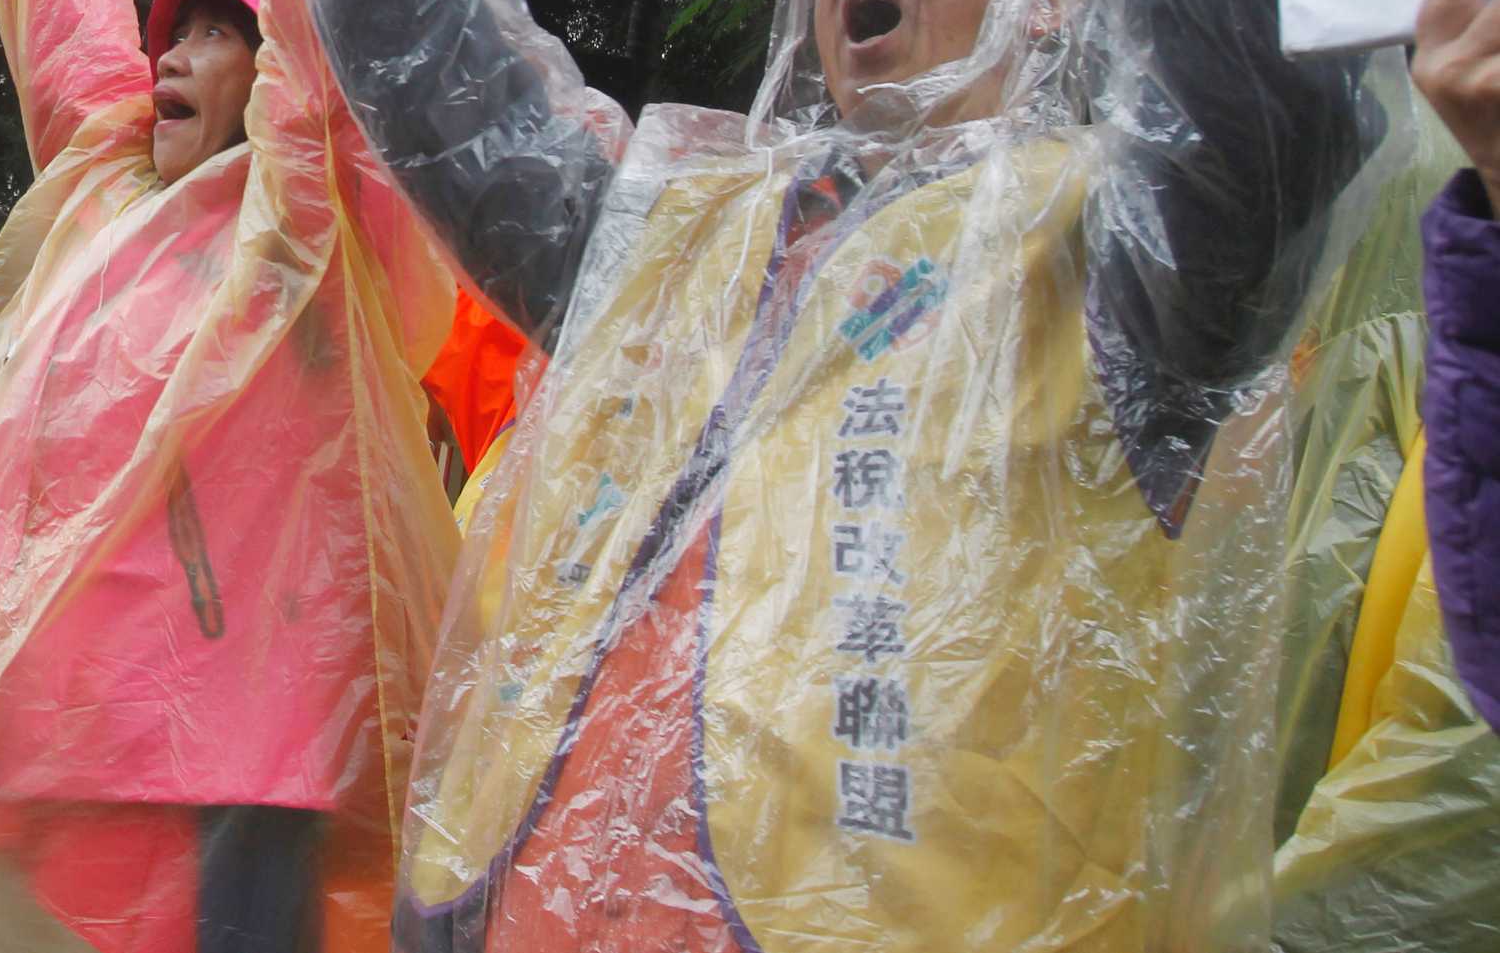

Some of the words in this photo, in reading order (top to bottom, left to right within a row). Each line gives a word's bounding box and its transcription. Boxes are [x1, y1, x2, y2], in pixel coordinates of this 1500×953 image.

[833, 376, 915, 843] 法稅改革聯盟
